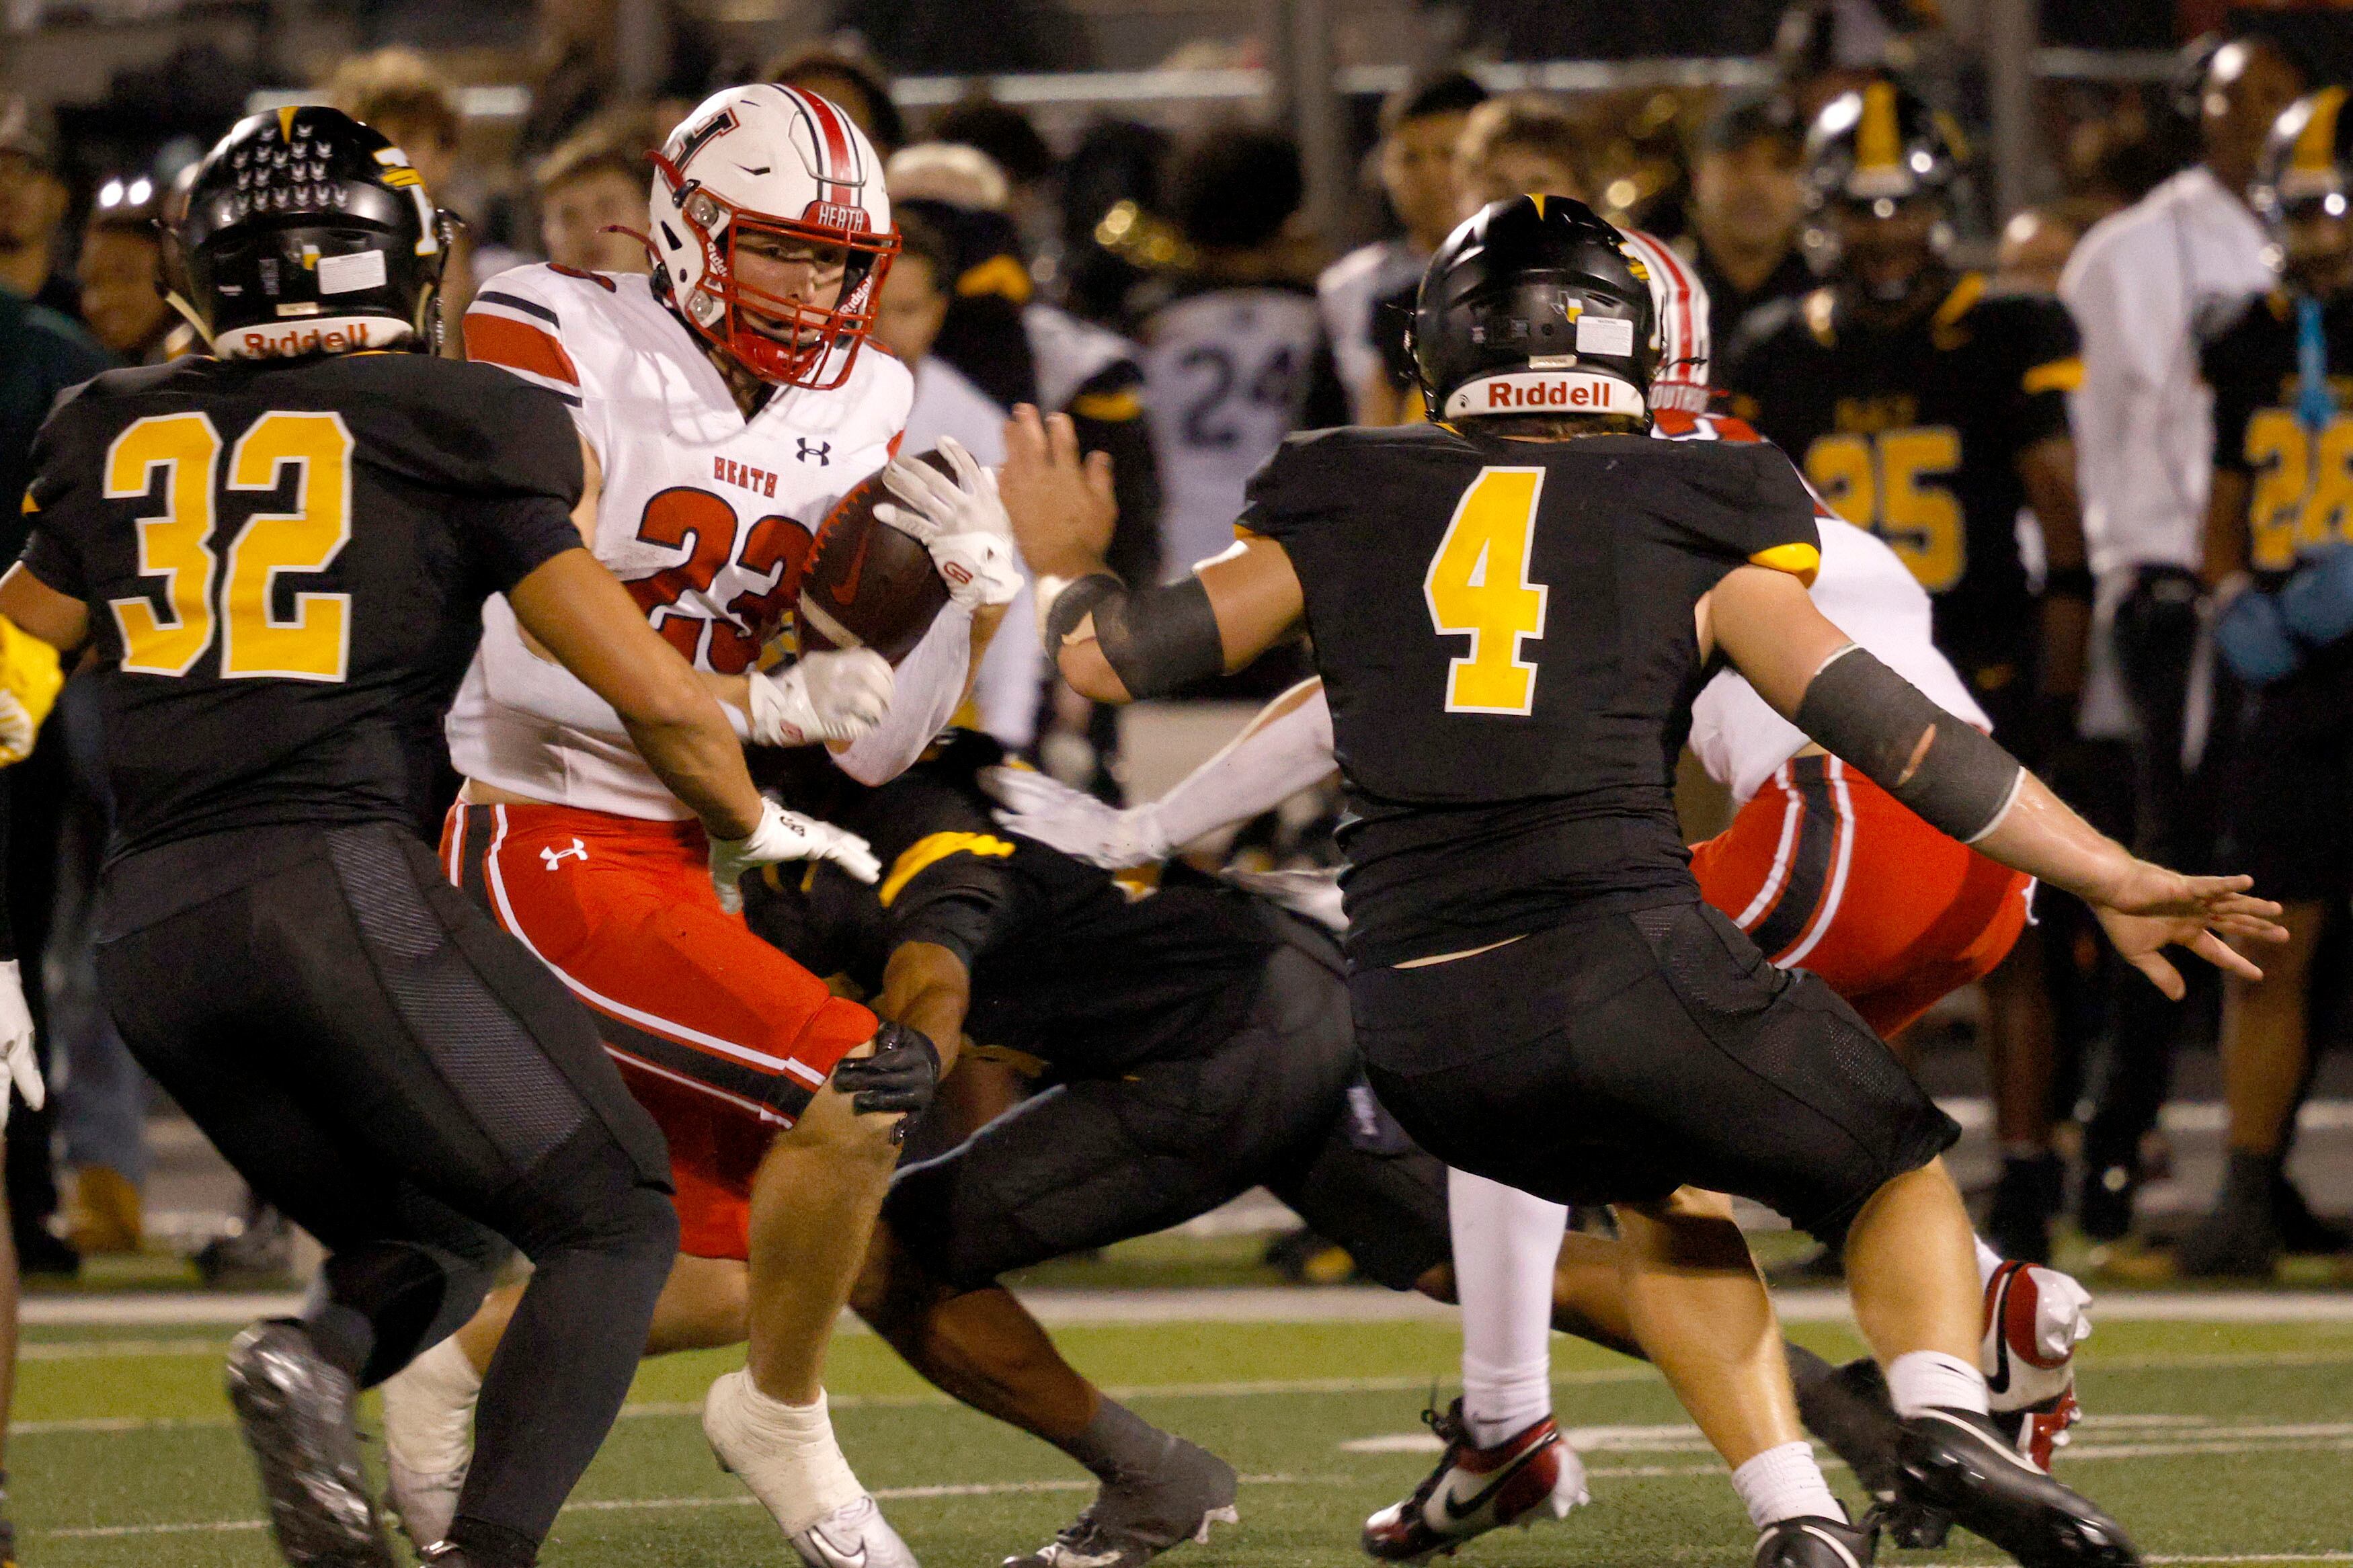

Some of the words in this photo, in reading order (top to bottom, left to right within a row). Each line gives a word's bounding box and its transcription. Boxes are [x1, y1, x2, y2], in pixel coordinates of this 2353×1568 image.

[817, 204, 863, 232] HEATH
[1488, 382, 1609, 407] Riddell
[714, 456, 778, 499] HEATH
[104, 411, 355, 682] 32
[620, 488, 815, 676] 23
[1423, 466, 1548, 716] 4
